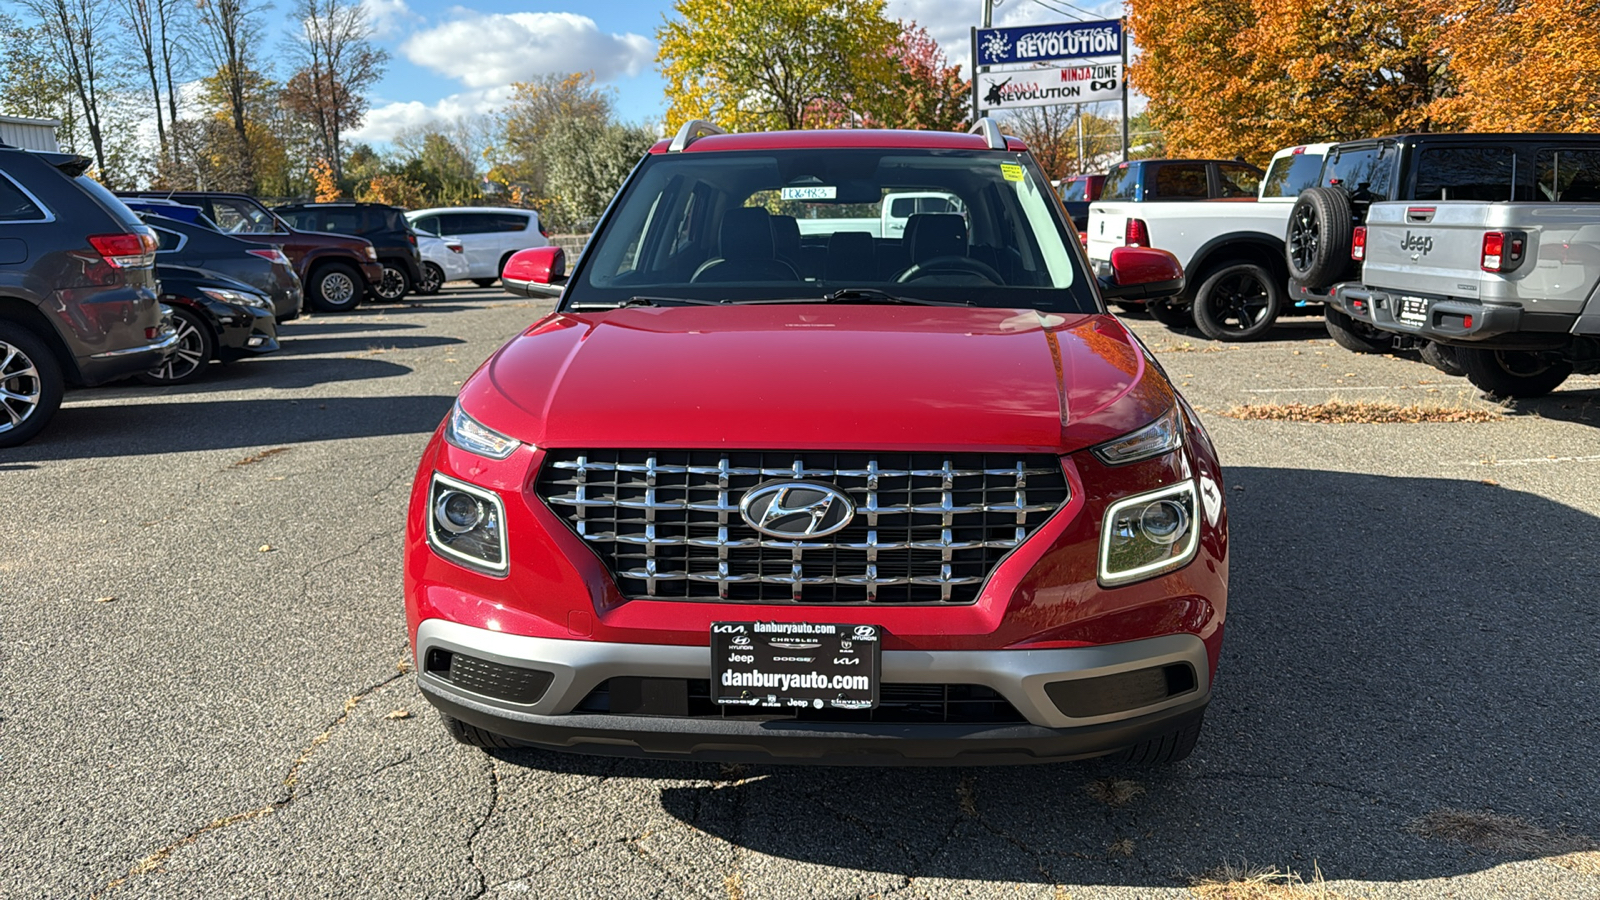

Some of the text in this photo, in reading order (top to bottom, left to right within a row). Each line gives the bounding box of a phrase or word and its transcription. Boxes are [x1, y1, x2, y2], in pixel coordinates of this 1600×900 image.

[1020, 27, 1113, 42] GYMNASTICS
[1016, 33, 1118, 58] REVOLUTION
[1000, 86, 1080, 102] REVOLUTION
[1400, 230, 1433, 255] Jeep
[754, 621, 836, 634] danburyauto.com
[728, 652, 754, 664] Jeep
[722, 669, 869, 691] danburyauto.com
[787, 698, 808, 707] Jeep
